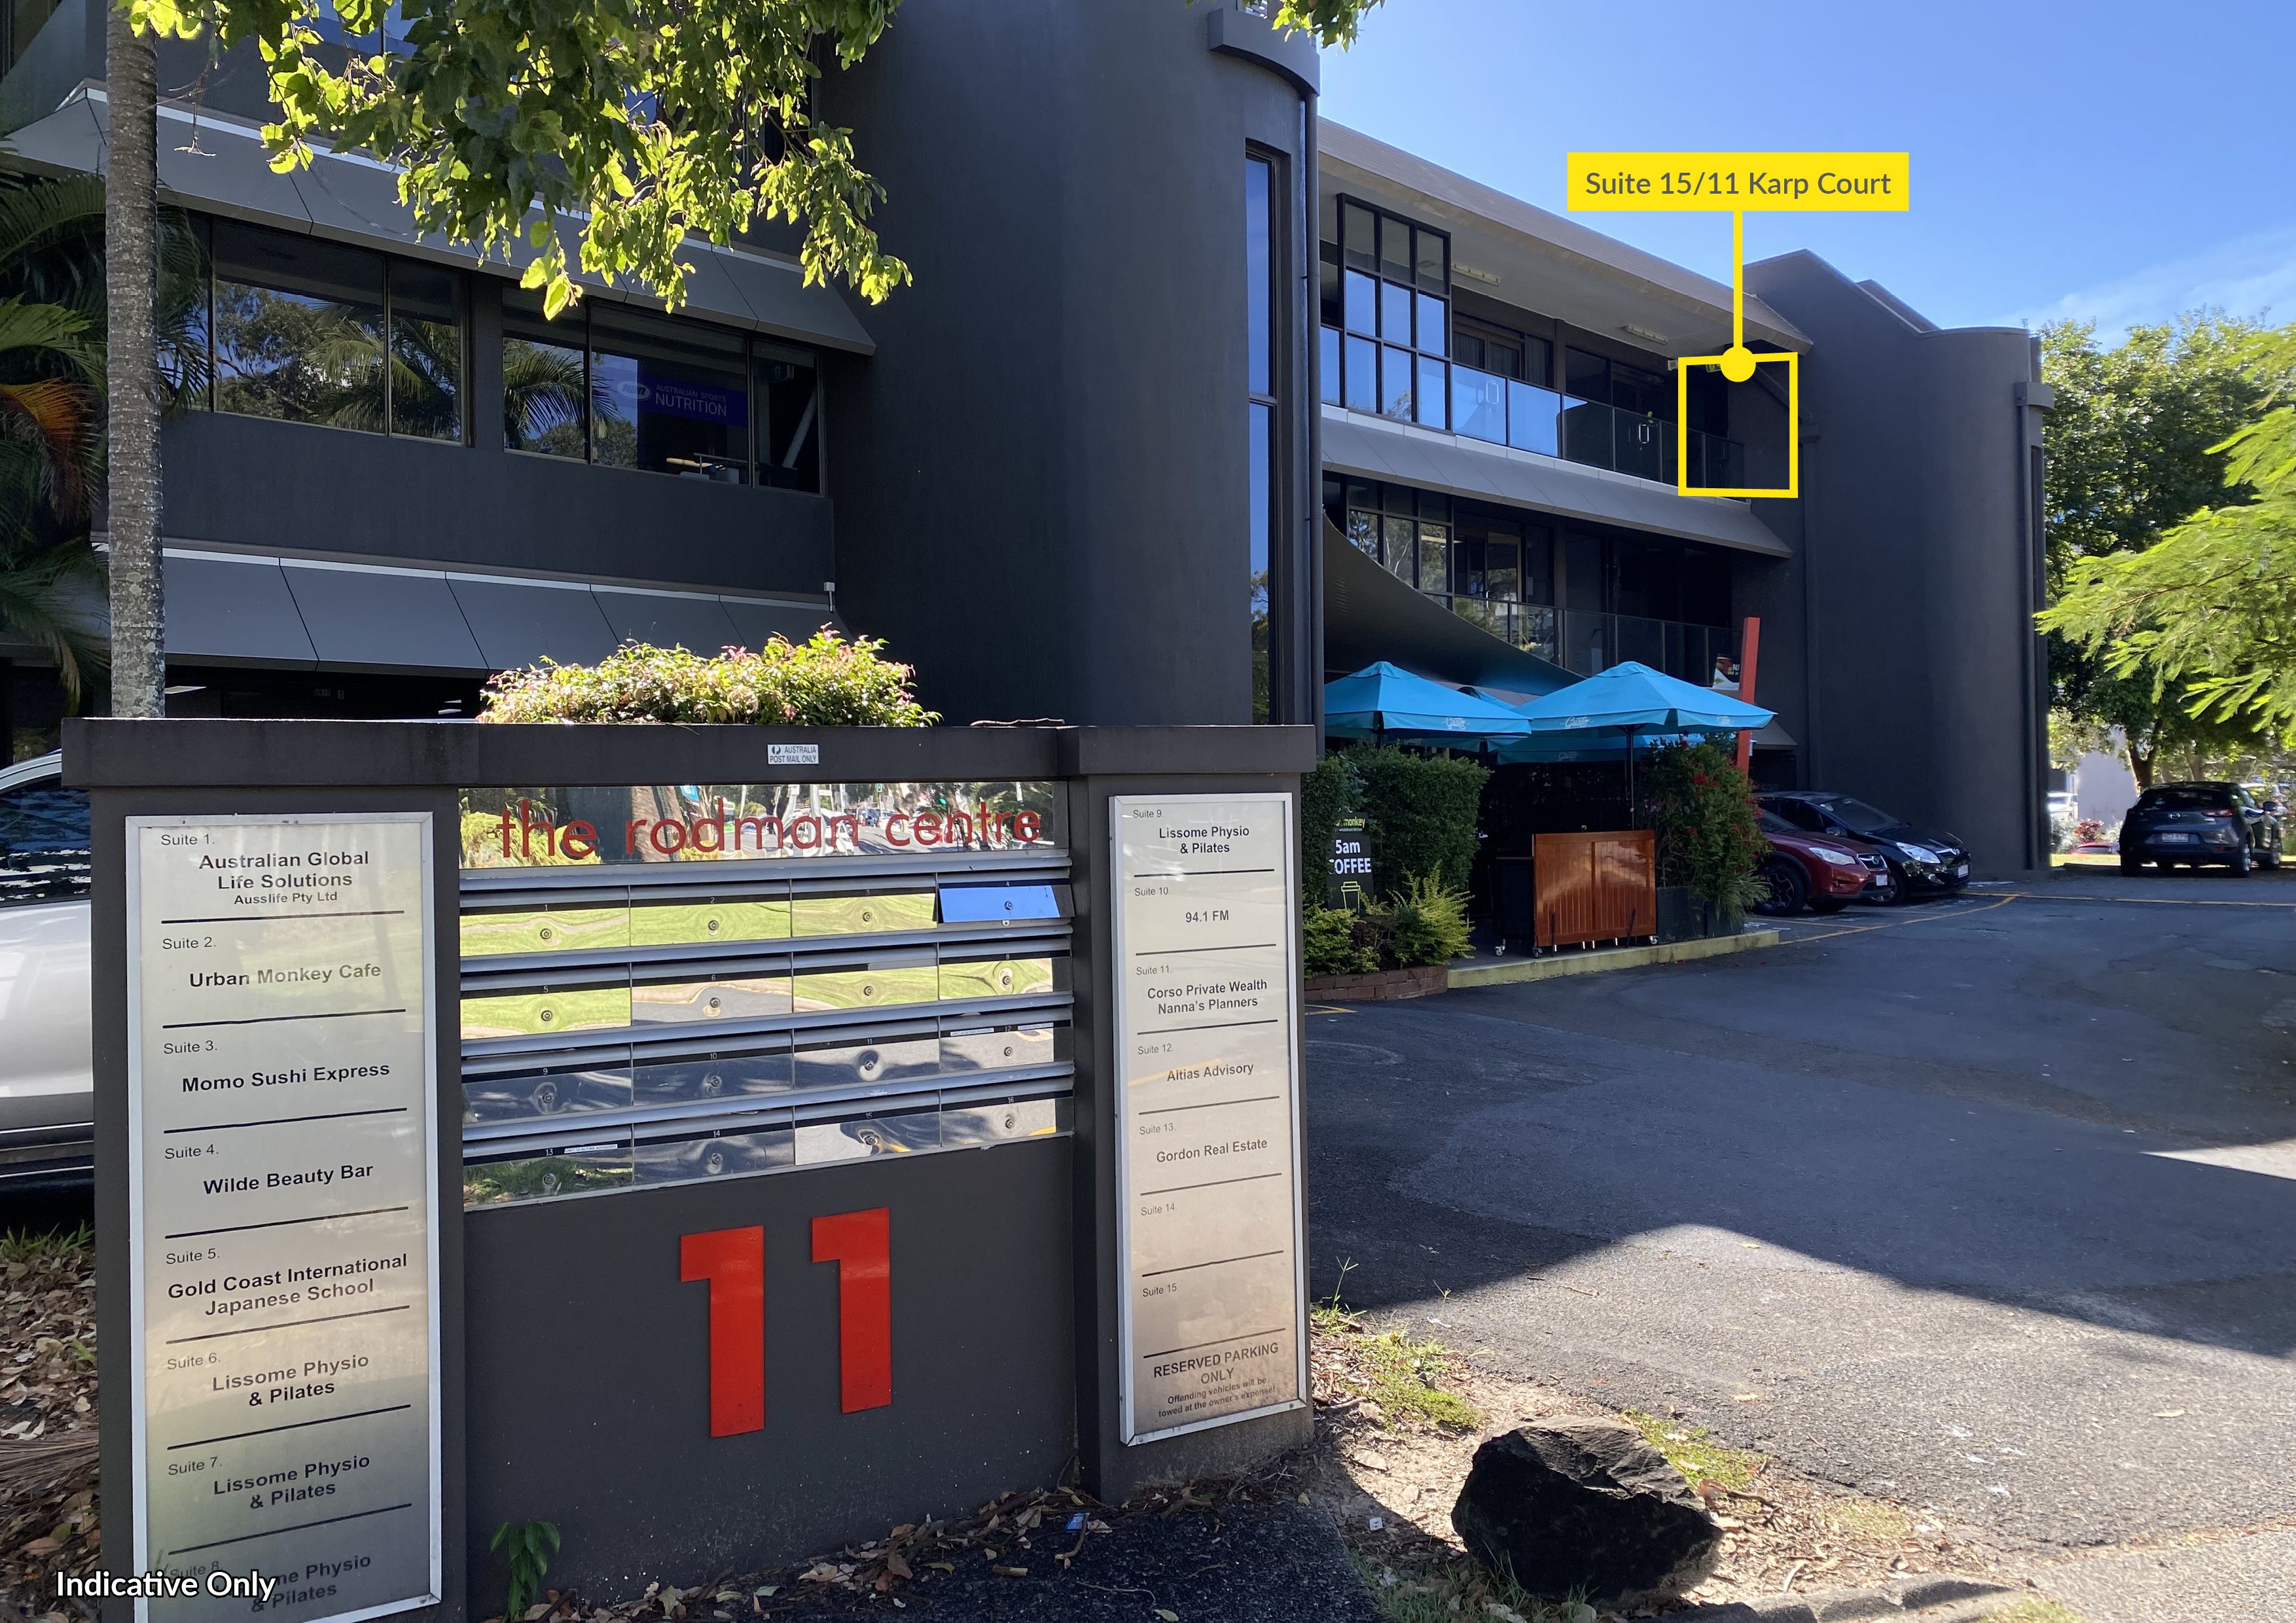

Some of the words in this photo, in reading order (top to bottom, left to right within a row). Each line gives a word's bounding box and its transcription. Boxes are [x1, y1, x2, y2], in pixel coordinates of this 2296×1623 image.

[656, 385, 697, 397] AUSTRALIAN
[701, 393, 726, 402] SPORTS
[656, 393, 726, 417] NUTRITION
[1133, 810, 1154, 818] Suite
[1157, 809, 1164, 818] 9.
[497, 798, 599, 859] the
[625, 797, 859, 855] rodman
[886, 801, 1041, 846] centre
[1160, 829, 1208, 838] Lissome
[1211, 826, 1249, 839] Physio
[162, 834, 197, 845] Suite
[204, 834, 215, 844] 1.
[1181, 844, 1188, 853] &
[1193, 843, 1229, 853] Pilates
[1336, 840, 1361, 854] 5am
[199, 853, 300, 868] Australian
[308, 851, 368, 865] Global
[219, 876, 253, 889] Life
[261, 873, 351, 887] Solutions
[234, 894, 287, 904] Ausslife
[293, 893, 312, 904] Pty
[317, 891, 337, 901] Ltd
[1159, 887, 1170, 895] 10.
[1186, 912, 1207, 922] 94.1
[1213, 910, 1229, 921] FM
[163, 938, 198, 949] Suite
[204, 936, 216, 948] 2.
[190, 972, 249, 987] Urban
[258, 968, 332, 984] Monkey
[340, 963, 380, 978] Cafe
[1136, 967, 1157, 975] Suite
[1160, 965, 1172, 974] 11.
[1148, 988, 1182, 999] Corso
[1187, 984, 1225, 995] Private
[1230, 980, 1266, 991] Wealth
[1158, 1001, 1204, 1014] Nanna's
[1208, 997, 1258, 1010] Planners
[164, 1043, 200, 1054] Suite
[206, 1040, 217, 1052] 3.
[1138, 1046, 1158, 1054] Suite
[1162, 1043, 1172, 1052] 12.
[182, 1076, 243, 1092] Momo
[251, 1069, 306, 1086] Sushi
[314, 1065, 389, 1082] Express
[1167, 1070, 1199, 1081] Altias
[1203, 1063, 1253, 1079] Advisory
[1139, 1126, 1160, 1135] Suite
[1164, 1123, 1175, 1133] 13.
[165, 1147, 201, 1159] Suite
[206, 1144, 219, 1155] 4.
[1157, 1149, 1200, 1162] Gordon
[1204, 1143, 1228, 1156] Real
[1233, 1139, 1266, 1152] Estate
[204, 1175, 259, 1194] Wilde
[268, 1169, 334, 1187] Beauty
[342, 1166, 373, 1179] Bar
[1141, 1206, 1162, 1215] Suite
[1165, 1204, 1177, 1213] 14.
[166, 1252, 202, 1264] Suite
[207, 1248, 220, 1260] 5.
[168, 1279, 215, 1298] Gold
[224, 1272, 281, 1291] Coast
[287, 1254, 407, 1283] International
[206, 1291, 300, 1317] Japanese
[308, 1278, 372, 1300] School
[1143, 1287, 1164, 1296] Suite
[1166, 1283, 1177, 1292] 15.
[680, 1207, 892, 1438] 11
[168, 1356, 203, 1370] Suite
[209, 1353, 221, 1364] 6.
[1154, 1354, 1221, 1378] RESERVED
[1225, 1342, 1278, 1363] PARKING
[212, 1368, 296, 1391] Lissome
[304, 1355, 368, 1379] Physio
[1201, 1368, 1234, 1384] ONLY
[249, 1392, 262, 1406] &
[270, 1383, 334, 1403] Pilates
[1168, 1390, 1206, 1404] Offending
[1209, 1383, 1240, 1395] vehicles
[1243, 1378, 1255, 1388] will
[1158, 1406, 1183, 1417] towed
[1209, 1395, 1239, 1406] owner's
[1242, 1385, 1275, 1399] expense!
[168, 1459, 205, 1476] Suite
[210, 1457, 222, 1468] 7.
[213, 1470, 298, 1495] Lissome
[305, 1455, 370, 1480] Physio
[251, 1495, 263, 1508] &
[270, 1481, 335, 1505] Pilates
[306, 1556, 371, 1579] Physio
[272, 1584, 336, 1608] Pilates
